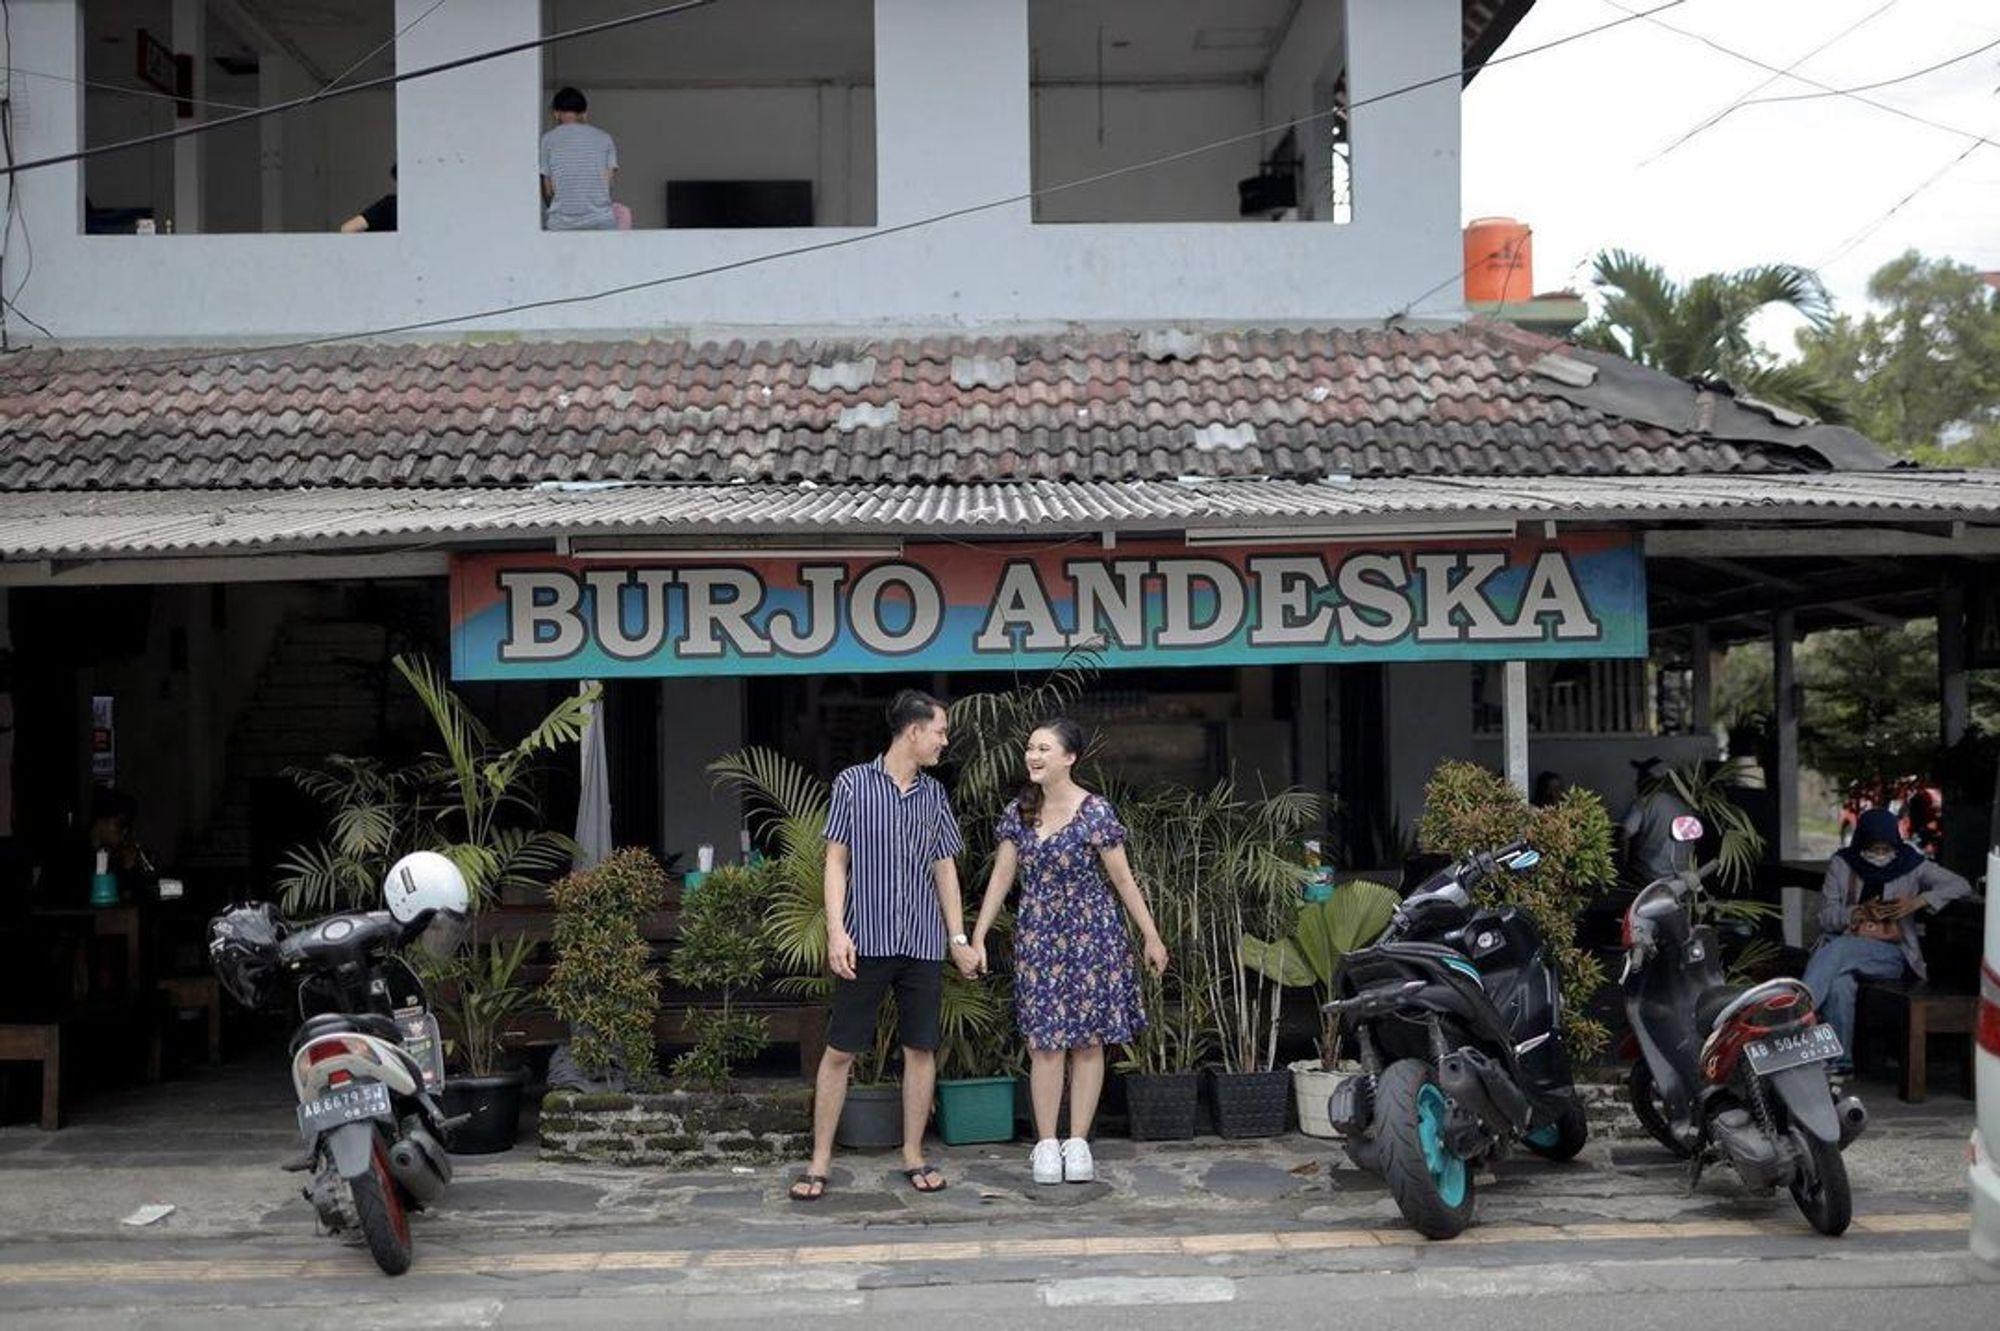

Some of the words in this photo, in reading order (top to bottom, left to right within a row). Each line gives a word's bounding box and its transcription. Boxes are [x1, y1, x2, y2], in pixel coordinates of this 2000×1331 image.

[498, 561, 946, 662] BURJO
[973, 548, 1601, 652] ANDESKA
[1749, 1043, 1769, 1058] AB
